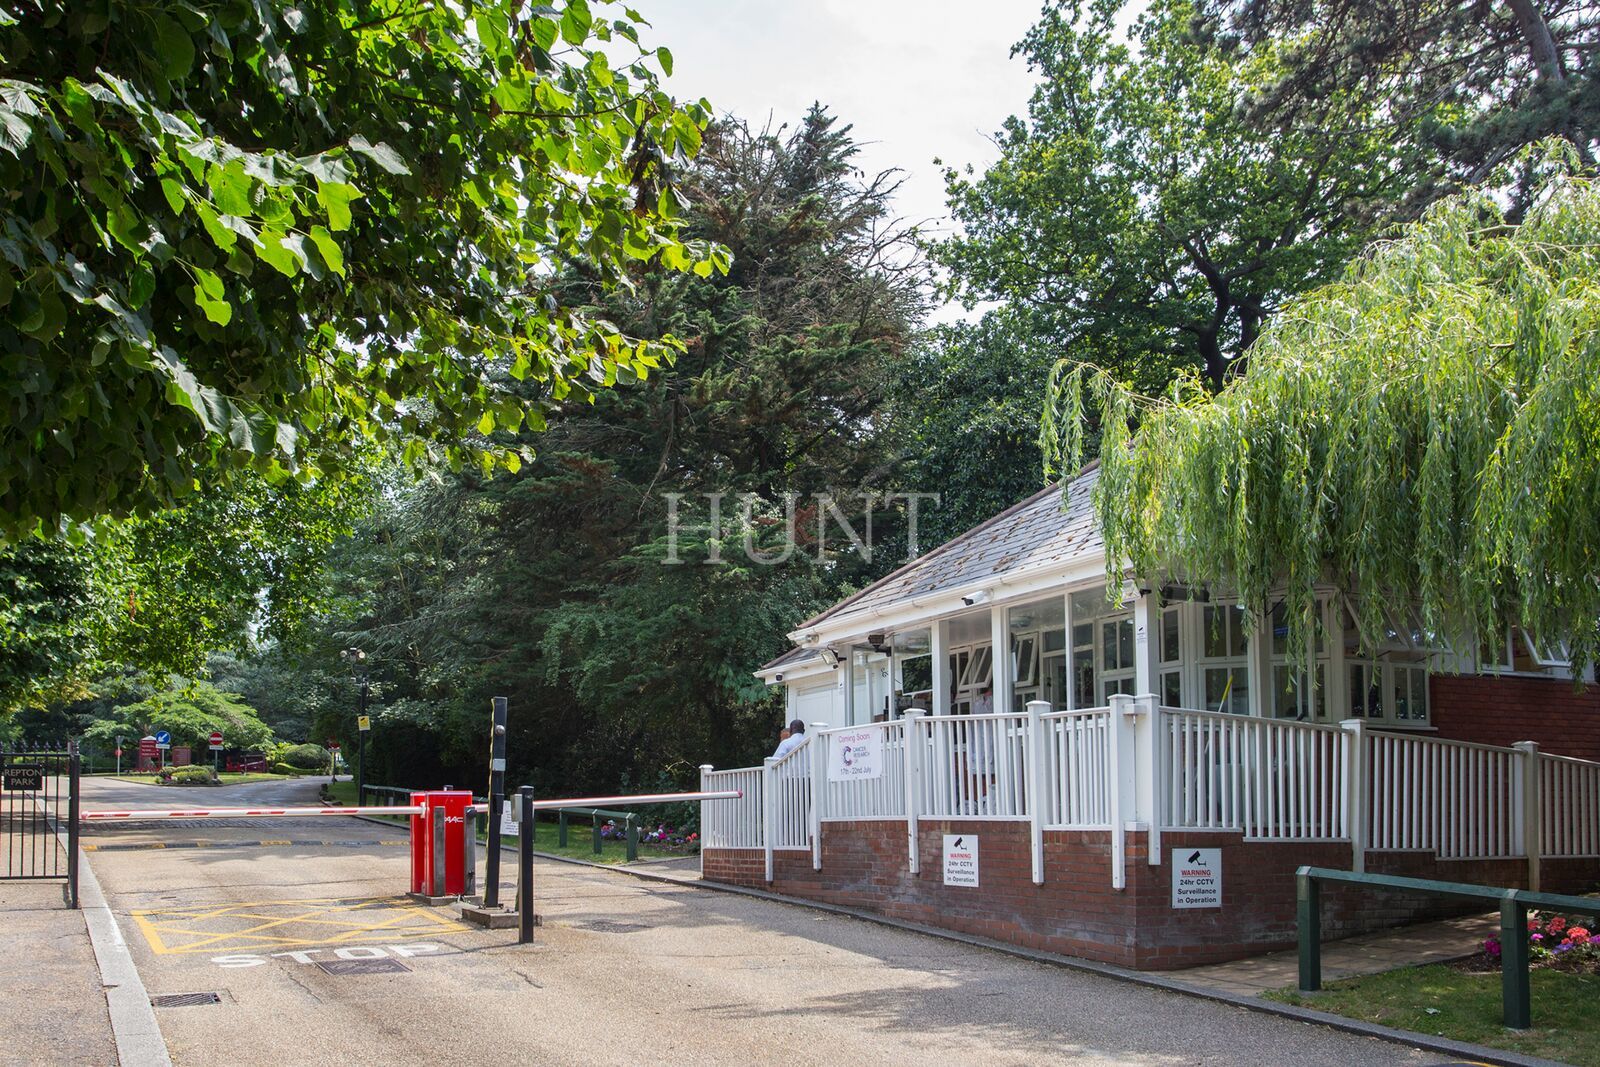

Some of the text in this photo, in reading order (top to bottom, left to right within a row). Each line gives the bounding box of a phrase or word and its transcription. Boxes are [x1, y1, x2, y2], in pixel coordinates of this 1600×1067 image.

[838, 733, 870, 743] Coming Soon
[4, 769, 42, 777] REPTON
[11, 778, 35, 786] PARK
[1186, 896, 1216, 904] Operation
[210, 944, 440, 968] STOP
